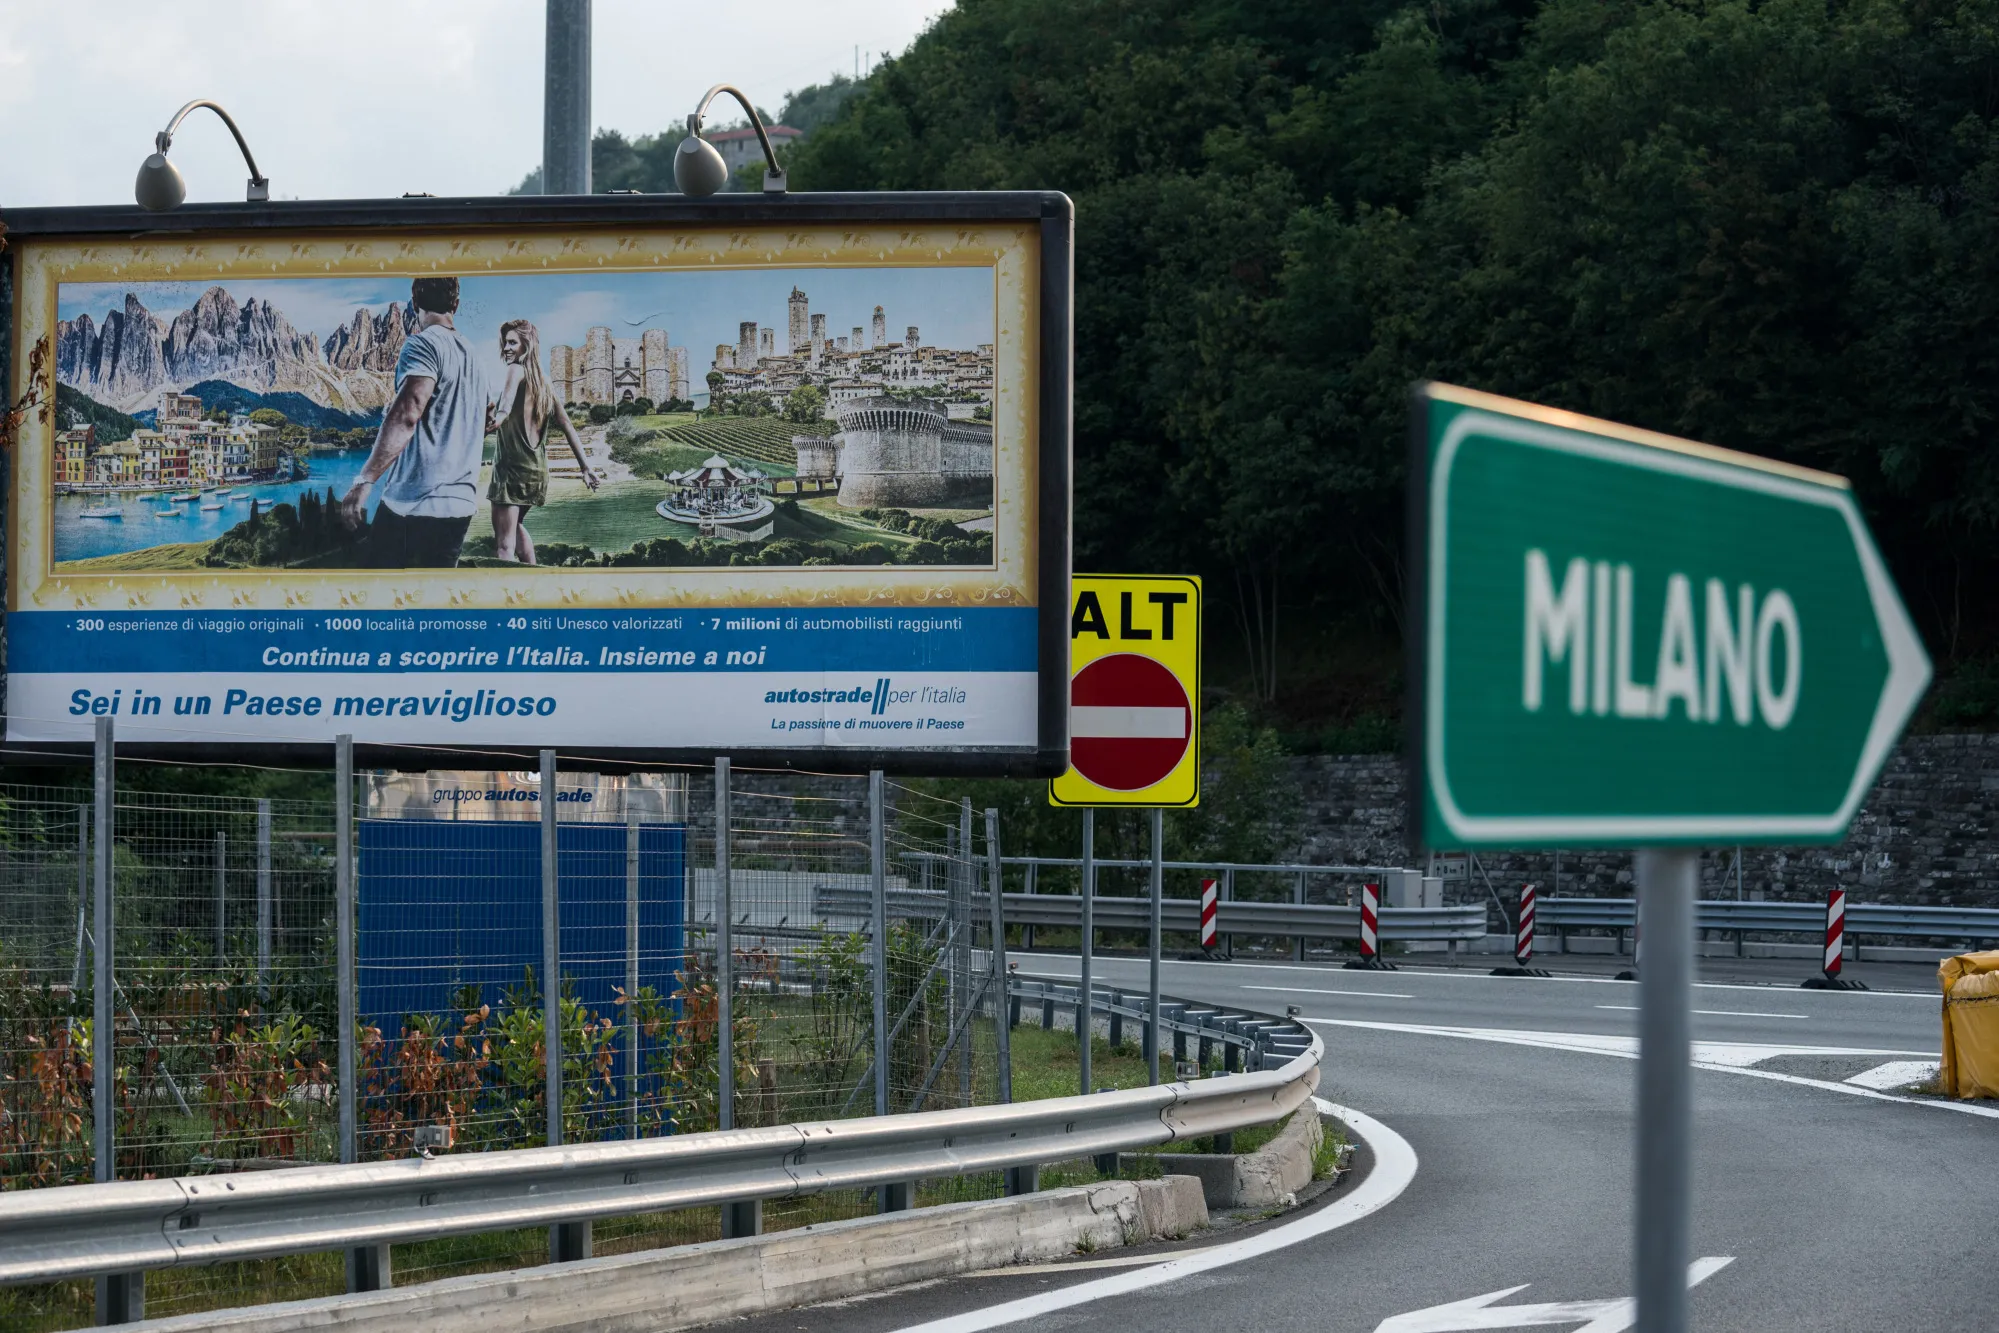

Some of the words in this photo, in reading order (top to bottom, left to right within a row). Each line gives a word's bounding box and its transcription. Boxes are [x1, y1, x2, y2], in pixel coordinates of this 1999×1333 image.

[77, 618, 104, 631] 300
[109, 619, 177, 633] esperienze
[182, 618, 194, 630] di
[198, 618, 245, 633] viaggio
[249, 618, 304, 633] originali
[325, 618, 362, 630] 1000
[367, 617, 415, 630] località
[419, 620, 487, 633] promosse
[507, 618, 527, 630] 40
[531, 617, 552, 630] siti
[556, 617, 608, 630] Unesco
[612, 617, 682, 630] valorizzati
[711, 618, 721, 630] 7
[726, 617, 781, 630] milioni
[785, 617, 798, 630] di
[802, 616, 893, 630] automobilisti
[898, 617, 962, 633] raggiunti
[1071, 590, 1188, 641] ALT
[1523, 548, 1801, 730] MILANO
[262, 646, 371, 667] Continua
[378, 652, 392, 667] a
[399, 646, 499, 670] scoprire
[506, 646, 590, 666] l'Italia.
[599, 646, 696, 666] Insieme
[703, 651, 718, 666] a
[726, 645, 767, 666] noi
[68, 688, 122, 716] Sei
[130, 688, 162, 716] in
[173, 695, 212, 716] un
[222, 688, 322, 717] Paese
[333, 689, 557, 723] meraviglioso
[764, 687, 873, 704] autostrade
[886, 688, 918, 707] per
[920, 686, 967, 704] l'italia
[770, 718, 786, 730] La
[844, 718, 856, 730] di
[858, 720, 913, 730] muovere
[915, 718, 924, 730] il
[926, 718, 965, 730] Paese
[433, 789, 482, 804] gruppo
[484, 787, 593, 803] autosade
